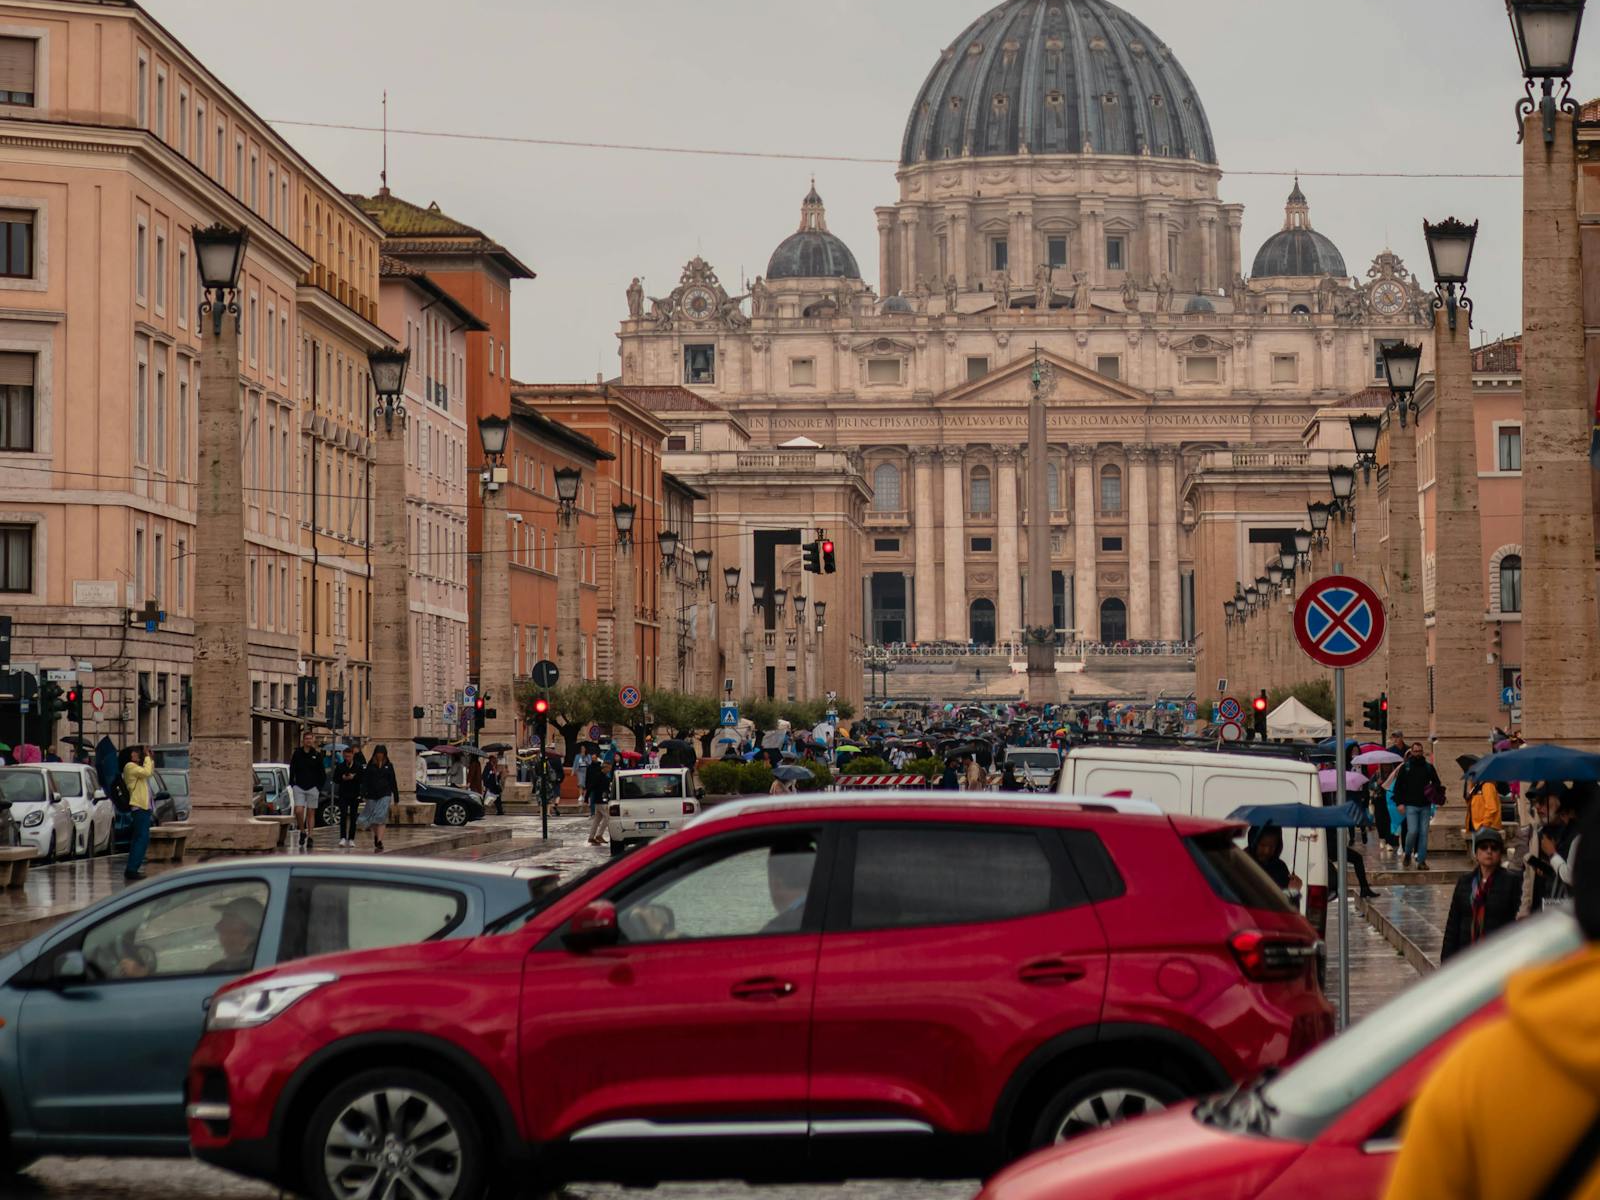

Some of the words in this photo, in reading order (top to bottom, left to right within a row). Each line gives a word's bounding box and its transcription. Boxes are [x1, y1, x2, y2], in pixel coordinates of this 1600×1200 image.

[750, 418, 764, 428] IN
[770, 417, 834, 429] HONOREM
[1080, 415, 1145, 426] ROMANVS
